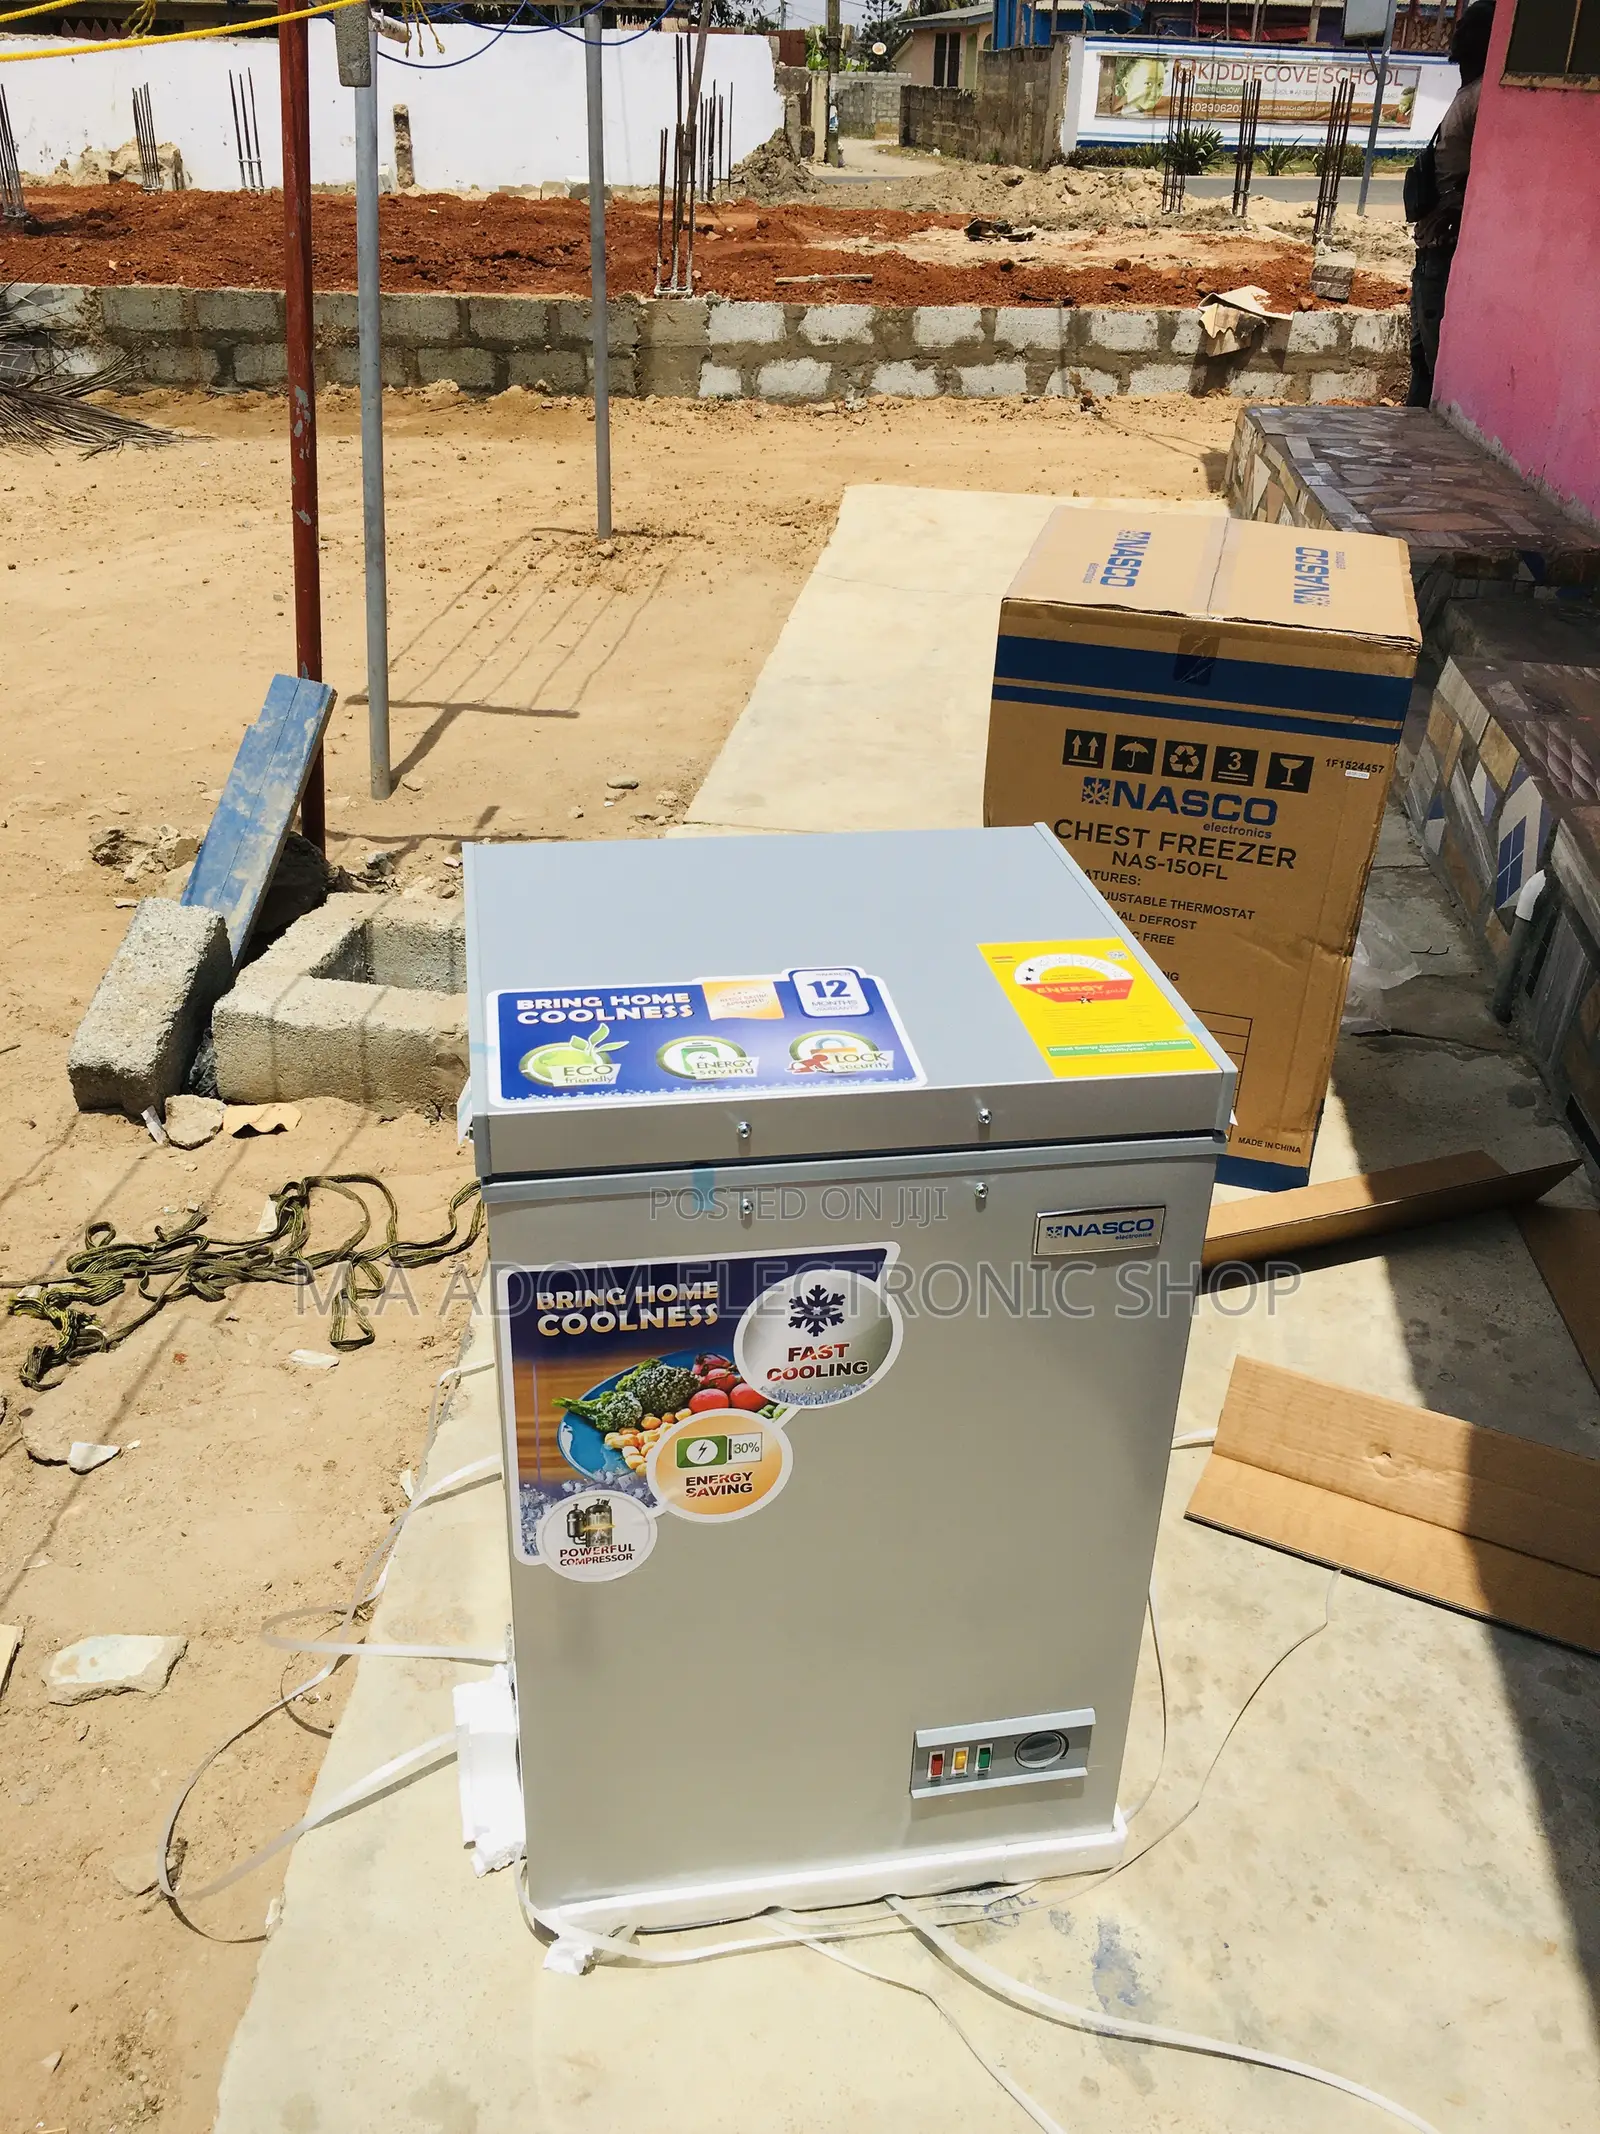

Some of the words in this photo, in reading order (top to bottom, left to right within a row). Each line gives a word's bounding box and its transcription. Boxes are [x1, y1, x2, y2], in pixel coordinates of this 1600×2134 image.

[1100, 537, 1149, 587] NASCO
[1293, 546, 1330, 597] NASCO
[1226, 751, 1243, 770] 3
[1325, 758, 1385, 774] 1F1524457
[1112, 780, 1278, 827] NASCO
[1203, 821, 1273, 840] electronics
[1053, 818, 1150, 849] CHEST
[1158, 831, 1297, 869] FREEZER
[1112, 851, 1228, 880] NAS-150FL
[1170, 900, 1255, 921] THERMOSTAT
[1139, 913, 1197, 930] DEFROST
[1143, 933, 1175, 946] FREE
[807, 980, 851, 998] 12
[517, 993, 607, 1011] BRING
[609, 992, 693, 1007] HOME
[517, 1005, 696, 1025] COOLNESS
[696, 1057, 753, 1071] ENERGY
[835, 1052, 885, 1064] LOCK
[837, 1060, 890, 1072] security
[563, 1064, 614, 1077] ECO
[564, 1073, 615, 1086] friendly
[698, 1067, 755, 1079] saving
[1237, 1136, 1263, 1148] MADE
[1264, 1141, 1274, 1149] IN
[1274, 1142, 1301, 1154] CHINA
[1063, 1218, 1155, 1238] NASCO
[536, 1286, 627, 1311] BRING
[635, 1281, 719, 1304] HOME
[536, 1304, 719, 1337] COOLNESS
[787, 1343, 851, 1362] FAST
[766, 1361, 869, 1383] COOLING
[733, 1440, 760, 1456] 30%
[685, 1471, 754, 1488] ENERGY
[685, 1482, 753, 1498] SAVING
[559, 1543, 636, 1558] POWERFUL
[559, 1552, 634, 1567] COMPRESSOR
